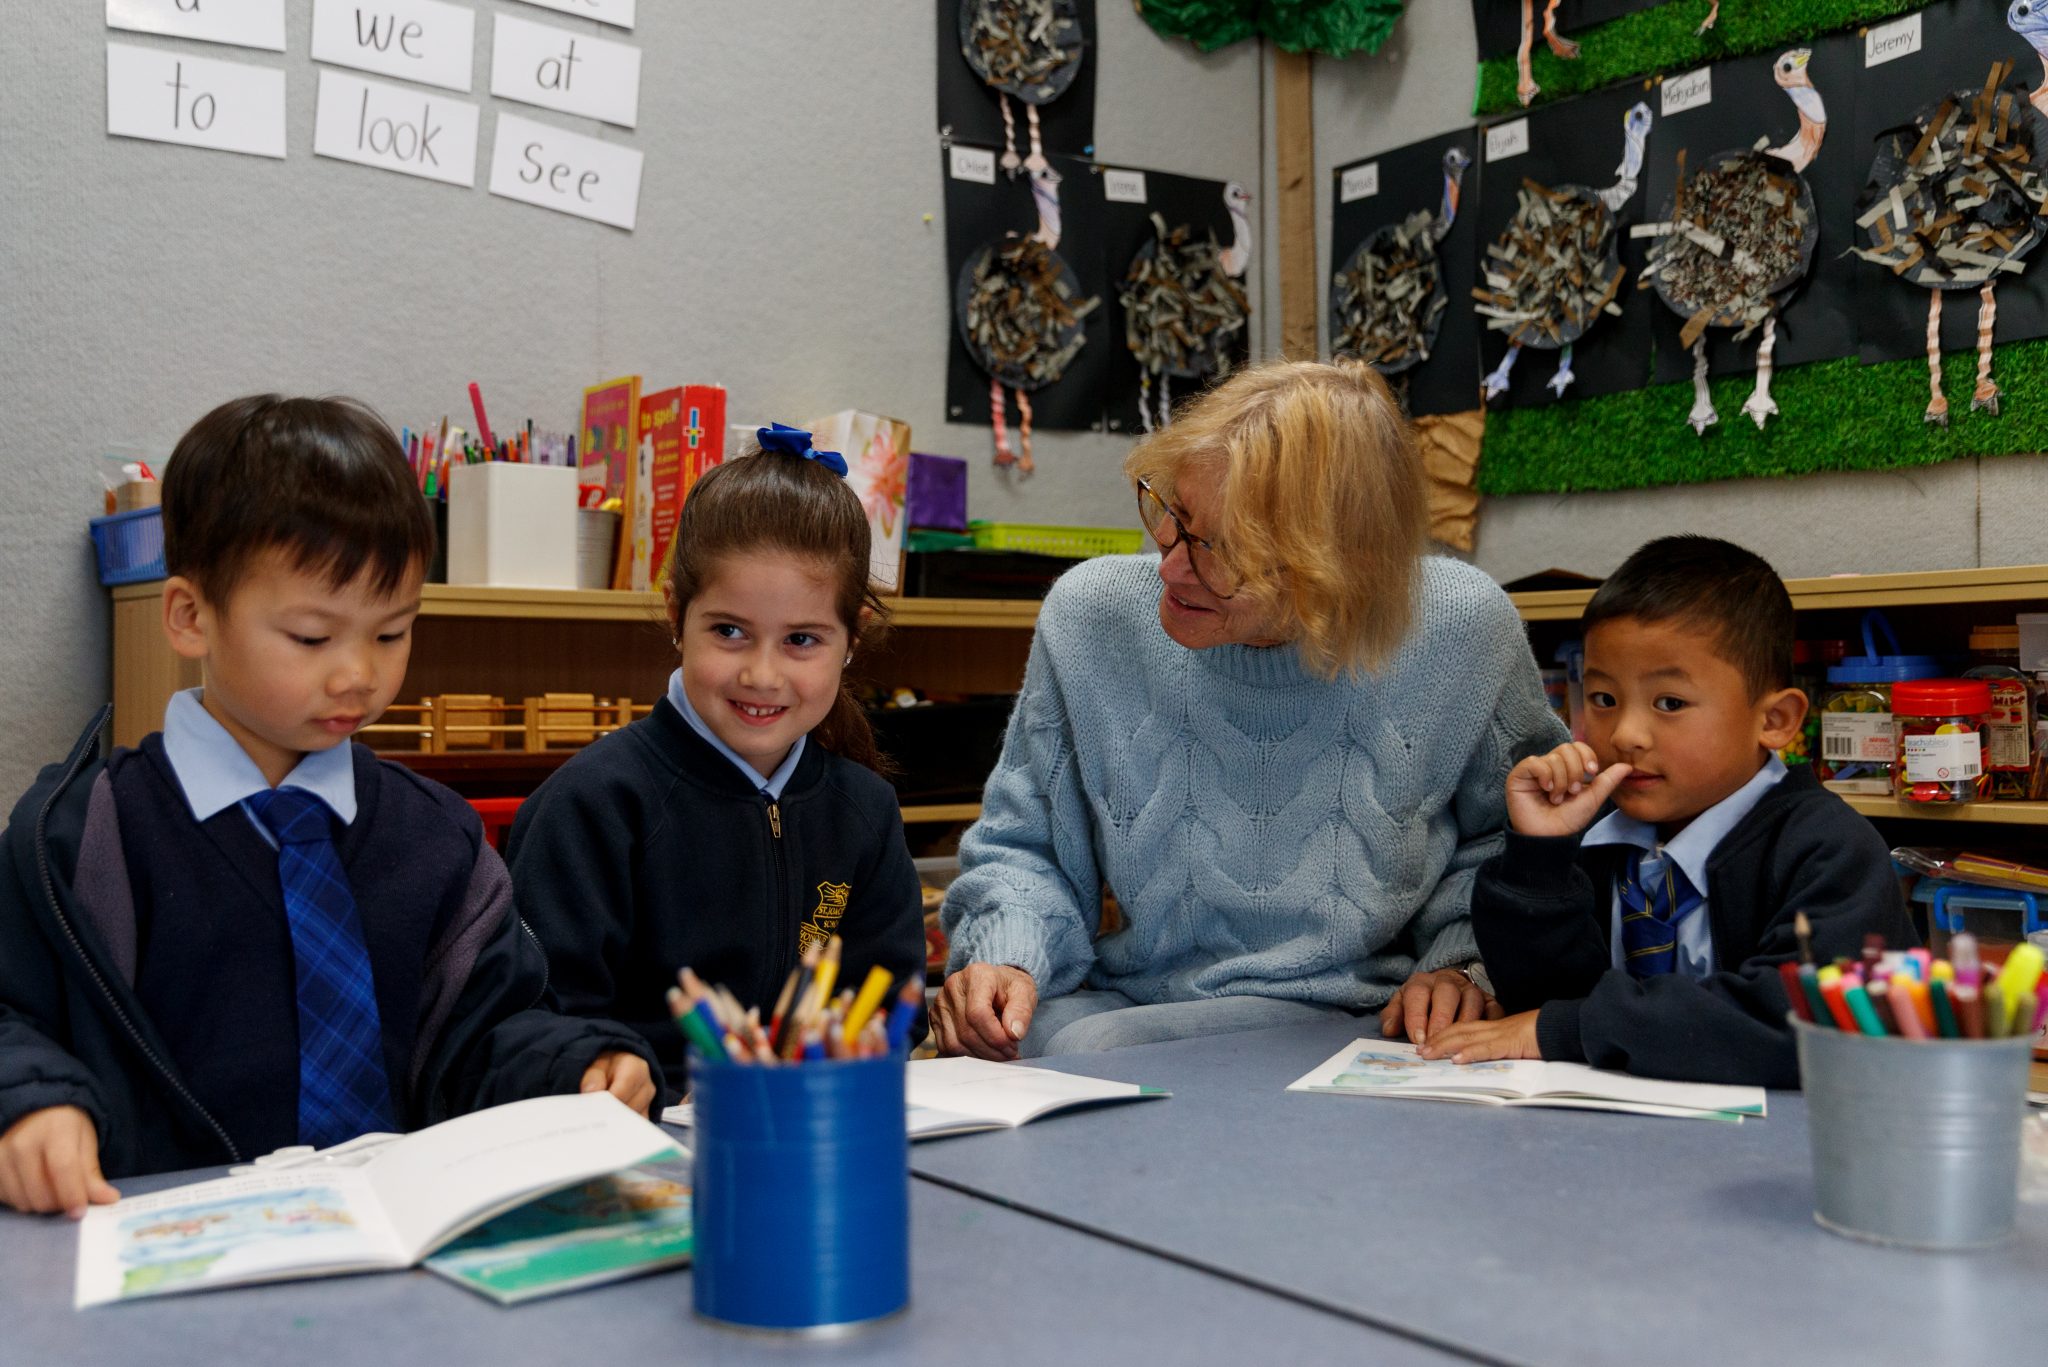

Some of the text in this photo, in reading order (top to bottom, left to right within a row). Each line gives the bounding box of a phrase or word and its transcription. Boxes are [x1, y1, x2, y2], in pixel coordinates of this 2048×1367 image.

[355, 9, 424, 59] we
[1867, 30, 1915, 59] Jeremy
[537, 40, 582, 92] at
[165, 62, 216, 131] to
[358, 87, 443, 167] look
